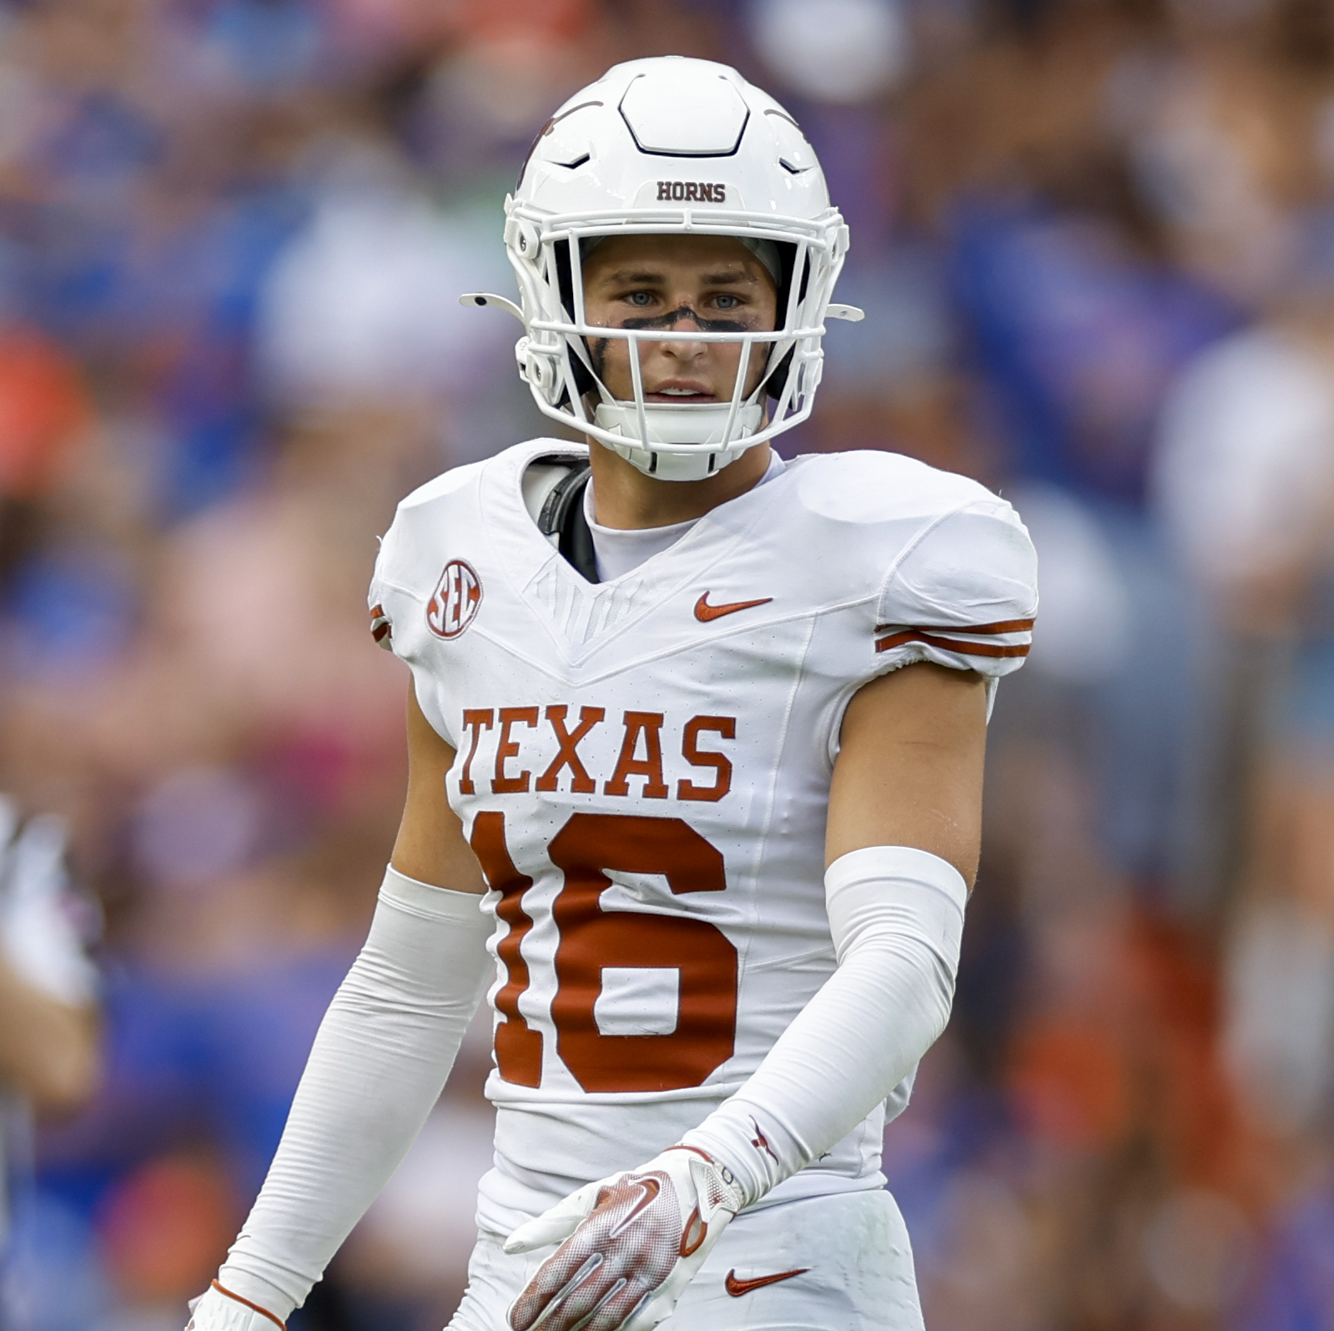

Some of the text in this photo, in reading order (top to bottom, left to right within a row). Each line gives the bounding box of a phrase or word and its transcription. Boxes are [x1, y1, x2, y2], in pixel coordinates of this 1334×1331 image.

[657, 181, 725, 203] HORNS
[427, 560, 481, 637] SEC
[459, 705, 736, 802] TEXAS
[470, 811, 738, 1094] 16
